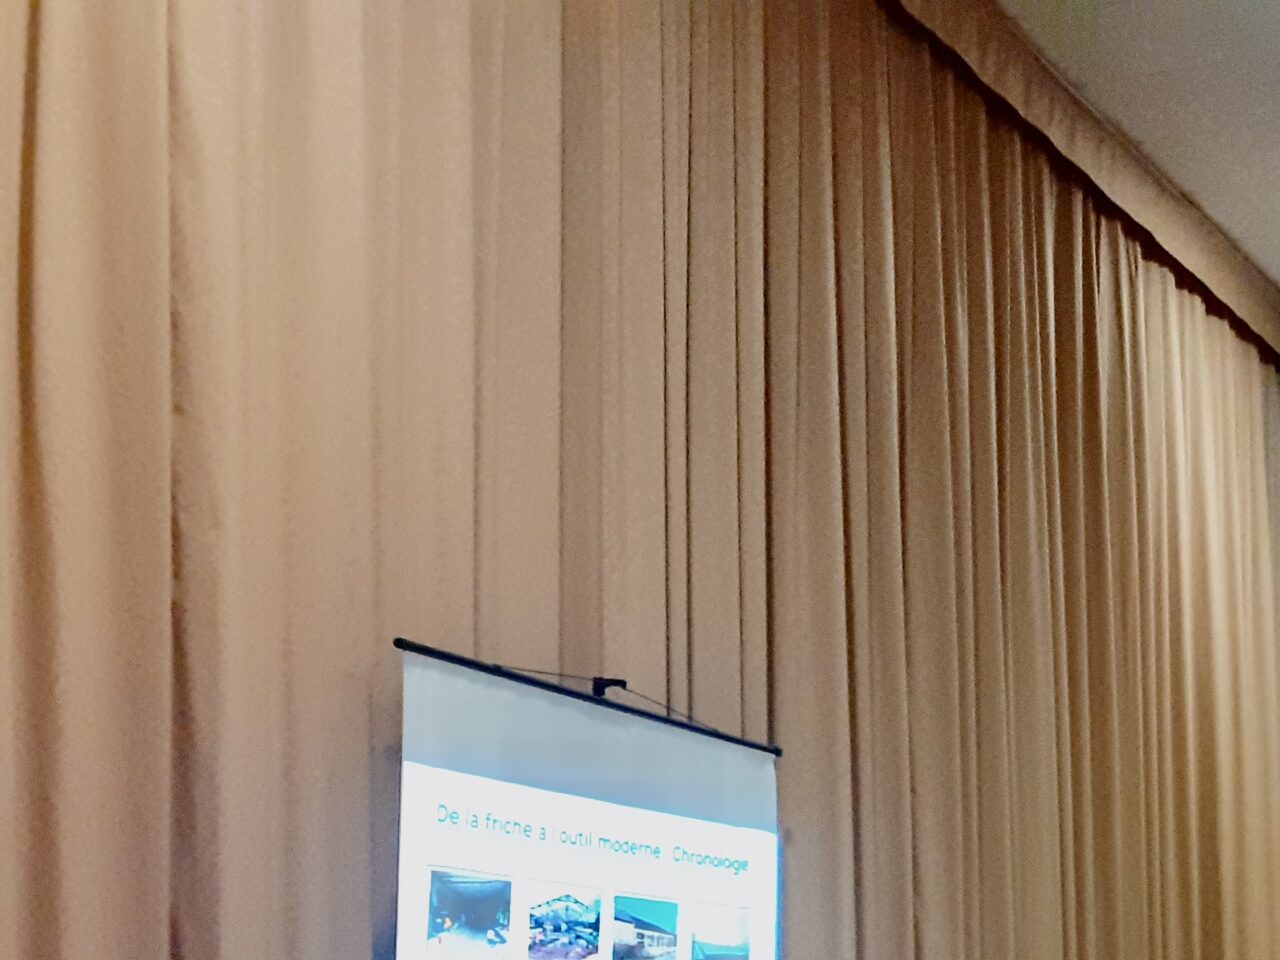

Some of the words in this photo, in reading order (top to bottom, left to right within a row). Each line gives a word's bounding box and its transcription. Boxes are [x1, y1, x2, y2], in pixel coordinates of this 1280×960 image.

[437, 803, 460, 825] De
[485, 812, 533, 838] friche
[598, 836, 662, 859] moderne
